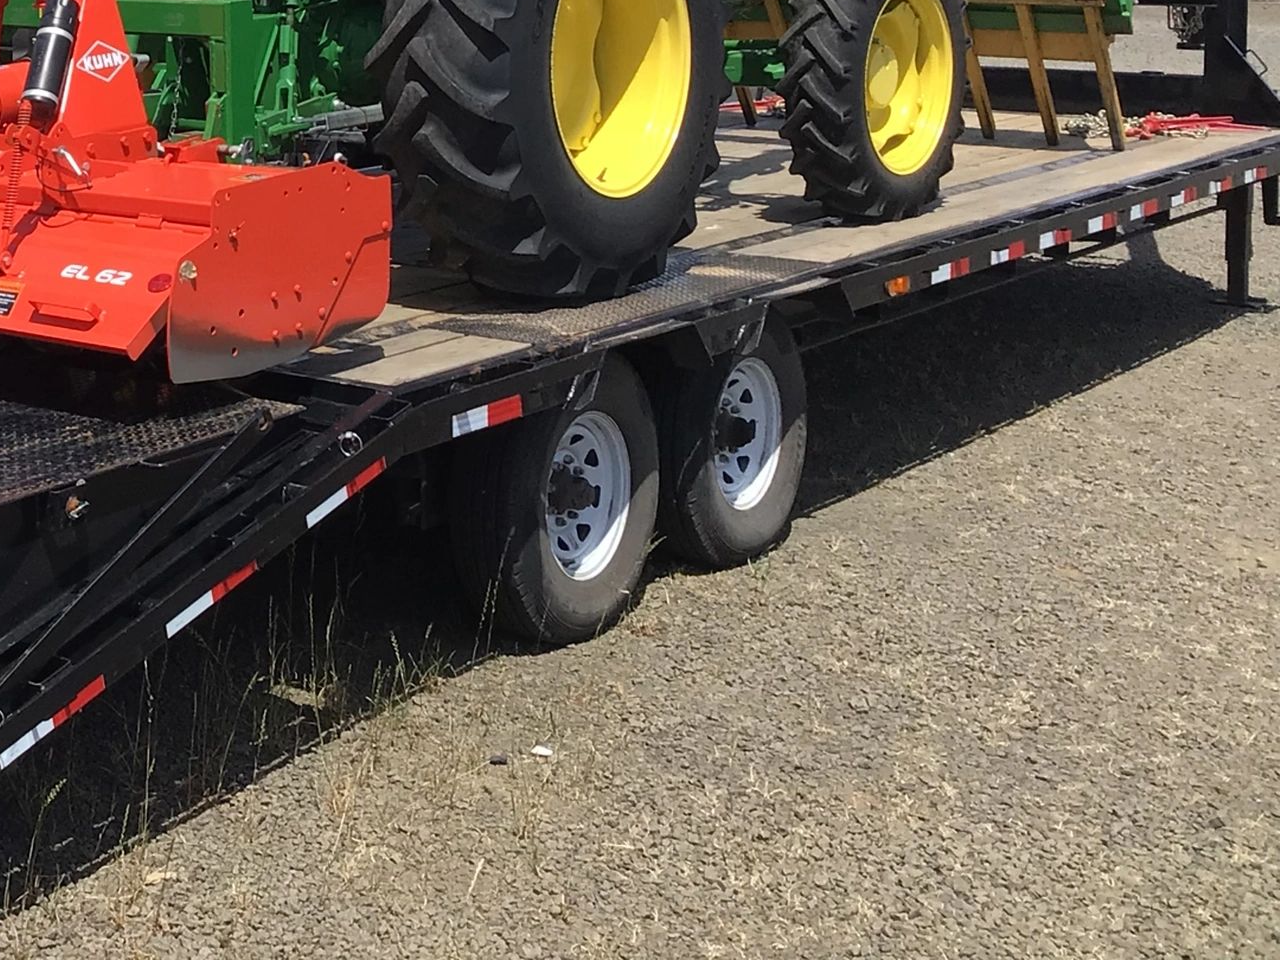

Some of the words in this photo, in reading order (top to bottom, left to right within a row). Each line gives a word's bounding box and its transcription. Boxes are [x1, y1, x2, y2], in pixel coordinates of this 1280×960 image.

[83, 52, 123, 71] KUHN
[60, 264, 90, 281] EL
[94, 269, 133, 286] 62
